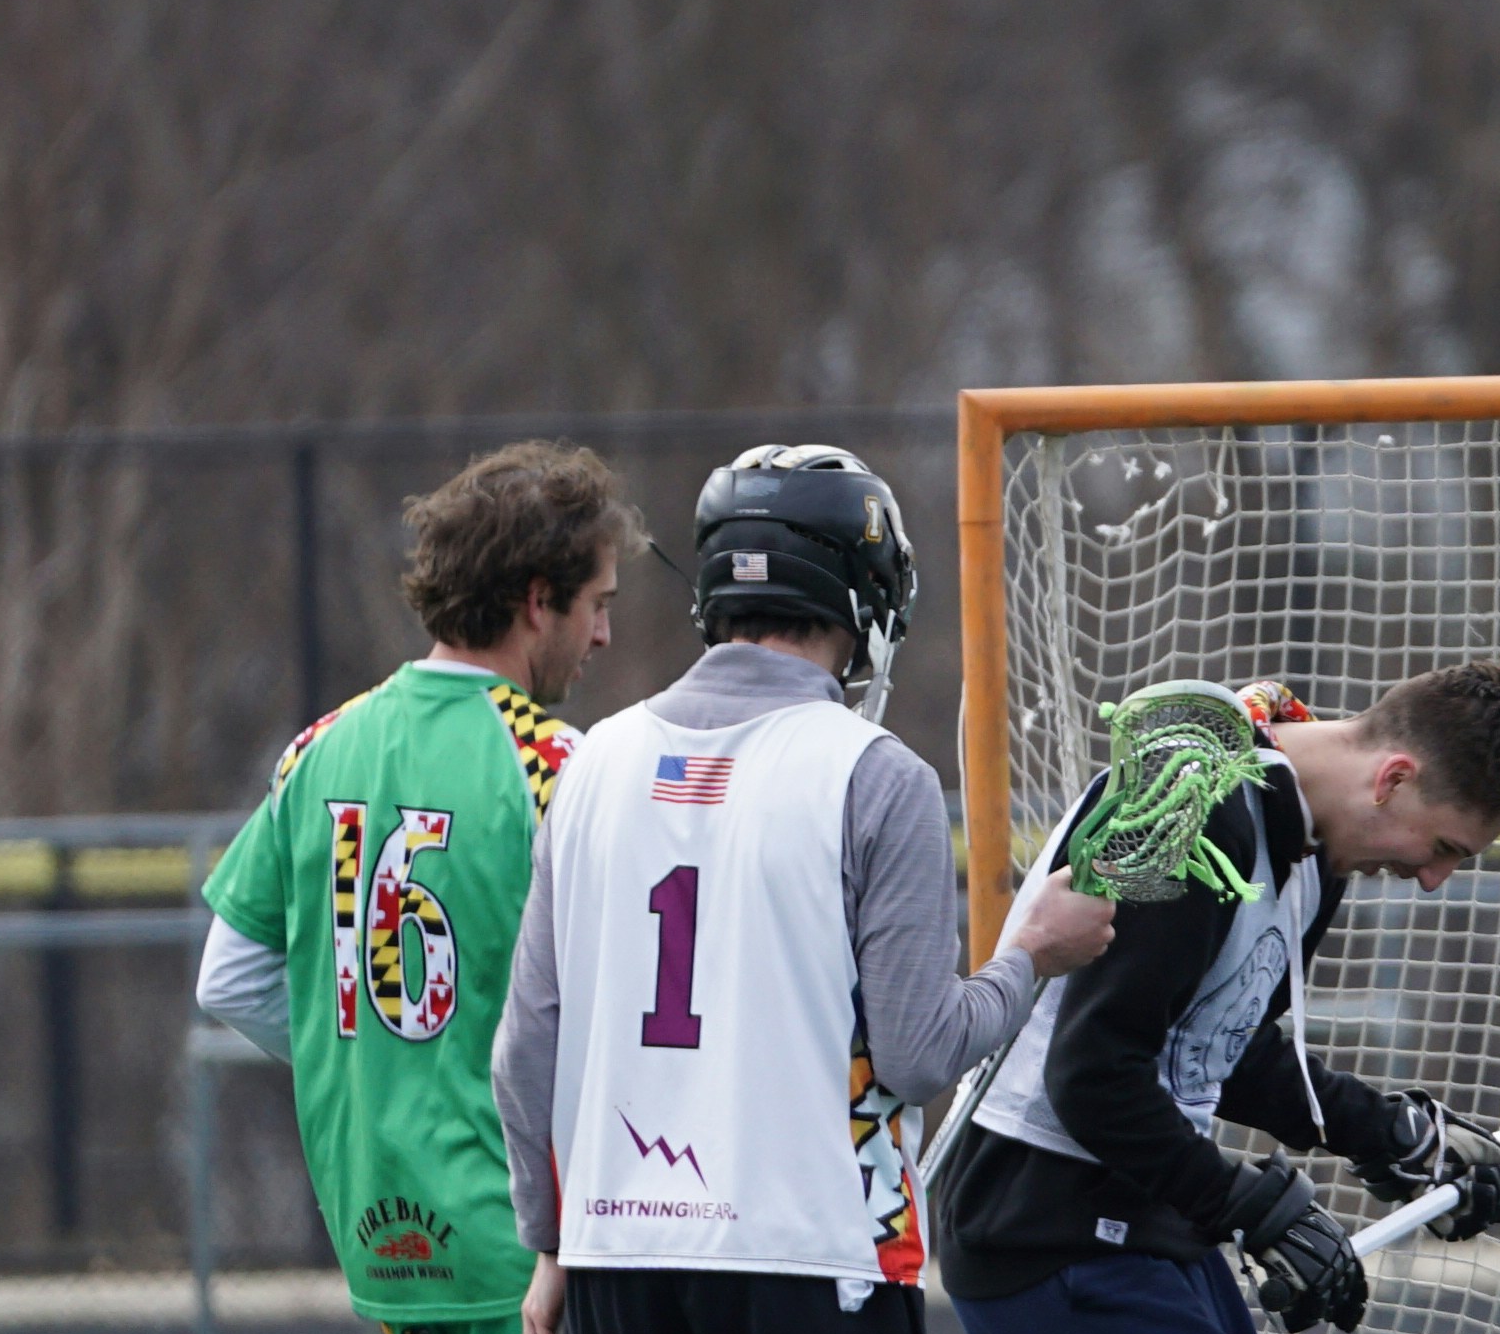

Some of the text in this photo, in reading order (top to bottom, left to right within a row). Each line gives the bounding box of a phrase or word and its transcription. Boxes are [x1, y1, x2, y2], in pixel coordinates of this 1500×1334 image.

[864, 495, 883, 544] 1
[323, 798, 458, 1043] 16
[641, 864, 702, 1049] 1
